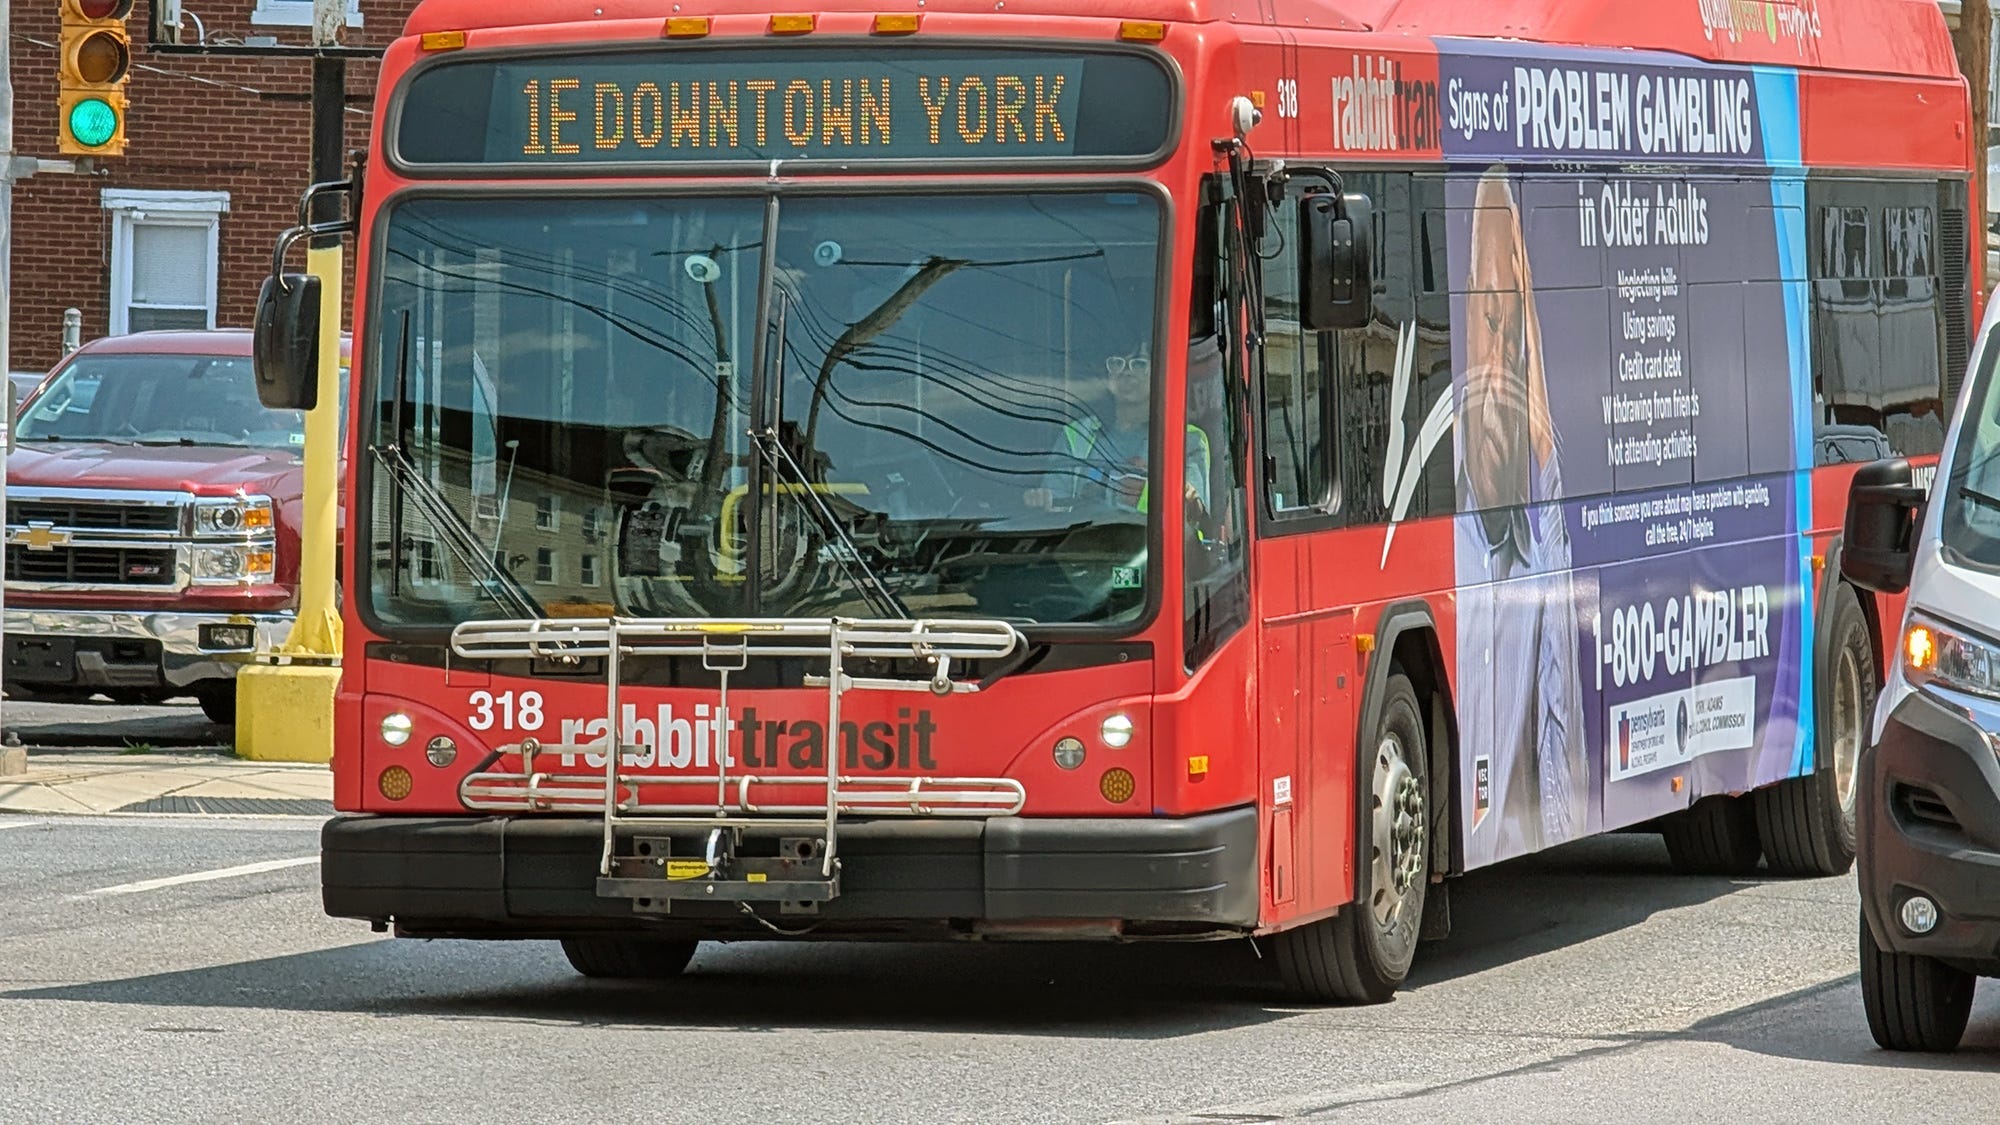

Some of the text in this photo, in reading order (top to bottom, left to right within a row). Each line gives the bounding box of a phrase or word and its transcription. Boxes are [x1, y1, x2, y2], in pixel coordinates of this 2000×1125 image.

[524, 74, 1065, 155] 1E DOWNTOWN YORK
[1277, 78, 1298, 118] 318
[1331, 54, 1441, 151] rabbittran
[1449, 66, 1751, 154] Signs of PROBLEM GAMBLING
[1578, 180, 1709, 247] in Older Adults
[1617, 267, 1678, 303] Neglecting bills
[1623, 308, 1676, 344] Using savings
[1619, 348, 1682, 382] Credit card debt
[1602, 393, 1653, 427] Wthdrawing
[1654, 390, 1673, 420] from
[1608, 428, 1698, 467] Not attending activities
[1587, 509, 1599, 531] you
[1599, 501, 1614, 525] think
[1614, 502, 1640, 523] someone
[1640, 501, 1651, 523] you
[1652, 499, 1664, 517] care
[1664, 493, 1680, 516] about
[1692, 490, 1705, 511] have
[1706, 492, 1710, 510] a
[1711, 486, 1732, 512] problem
[1732, 485, 1744, 506] with
[1646, 524, 1656, 546] call
[1656, 523, 1666, 545] the
[1592, 583, 1770, 691] 1-800-GAMBLER
[467, 690, 545, 731] 318
